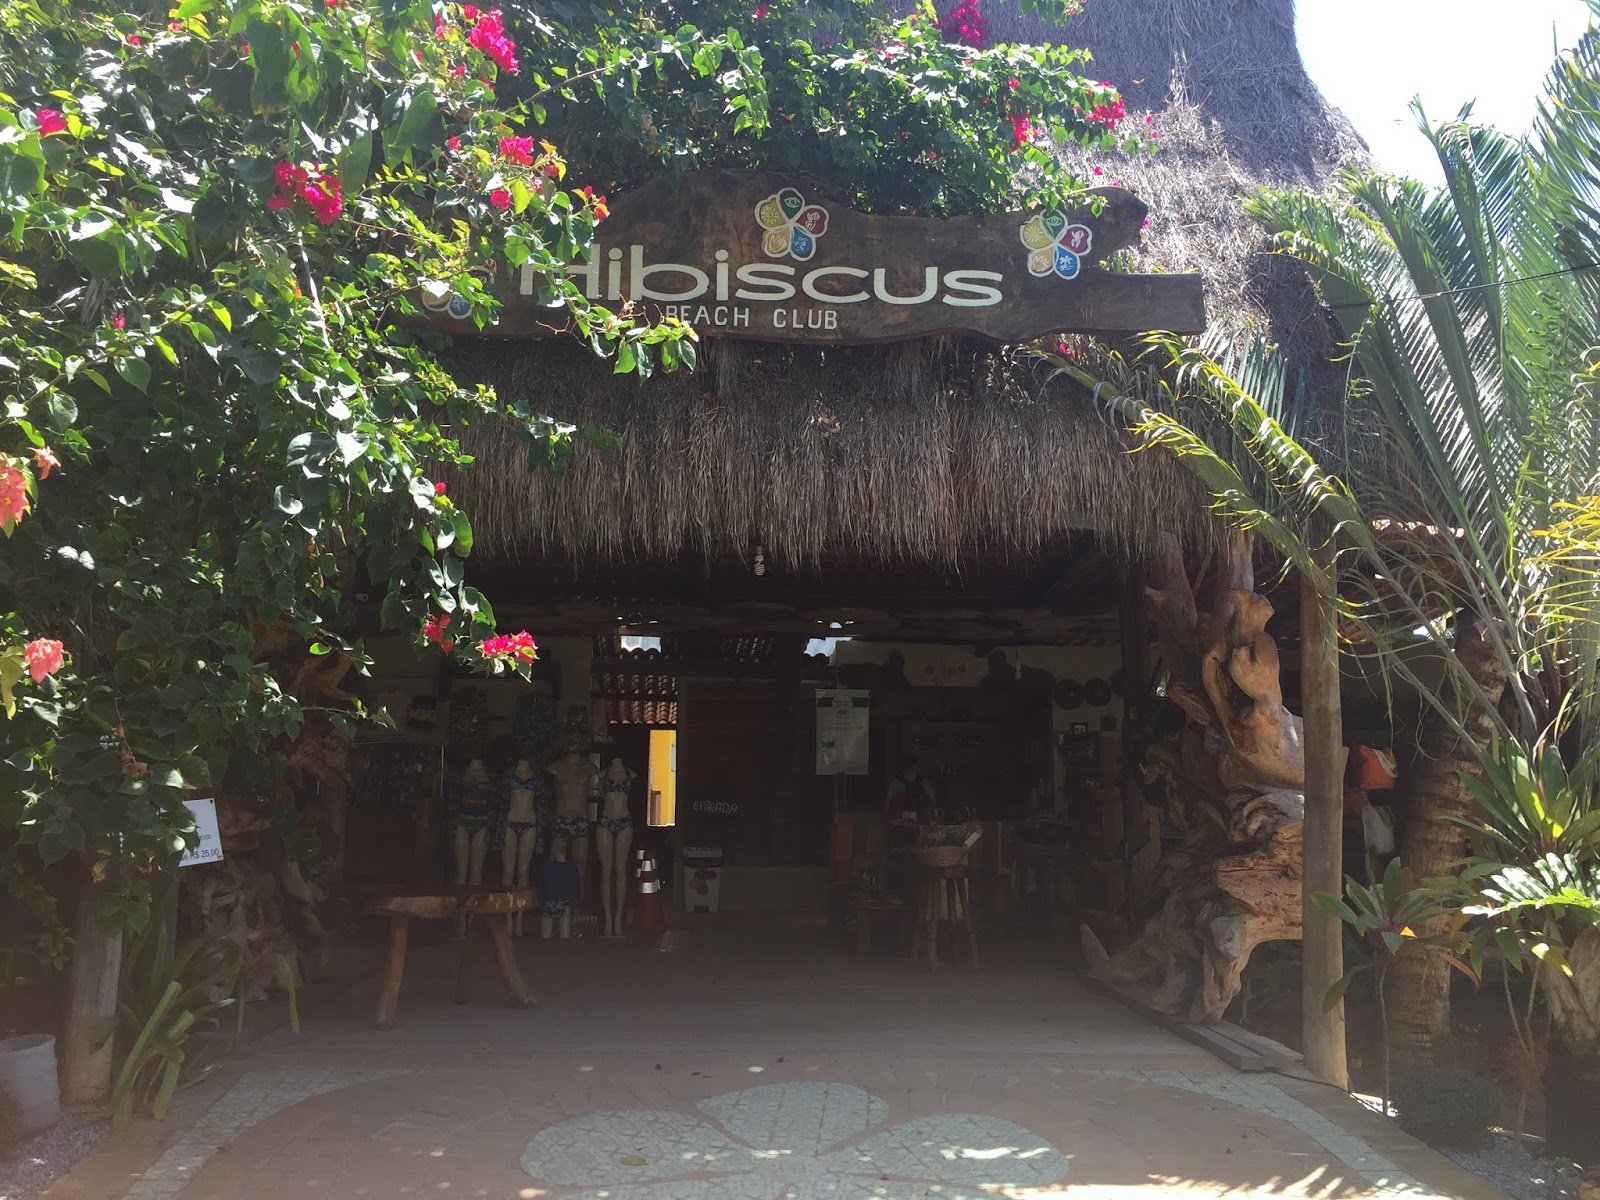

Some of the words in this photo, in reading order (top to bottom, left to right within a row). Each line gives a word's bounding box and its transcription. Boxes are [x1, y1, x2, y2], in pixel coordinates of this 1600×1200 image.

[520, 244, 1003, 307] Hibiscus
[665, 304, 749, 327] BEACH
[773, 308, 838, 330] CLUB
[200, 848, 219, 858] 25,00
